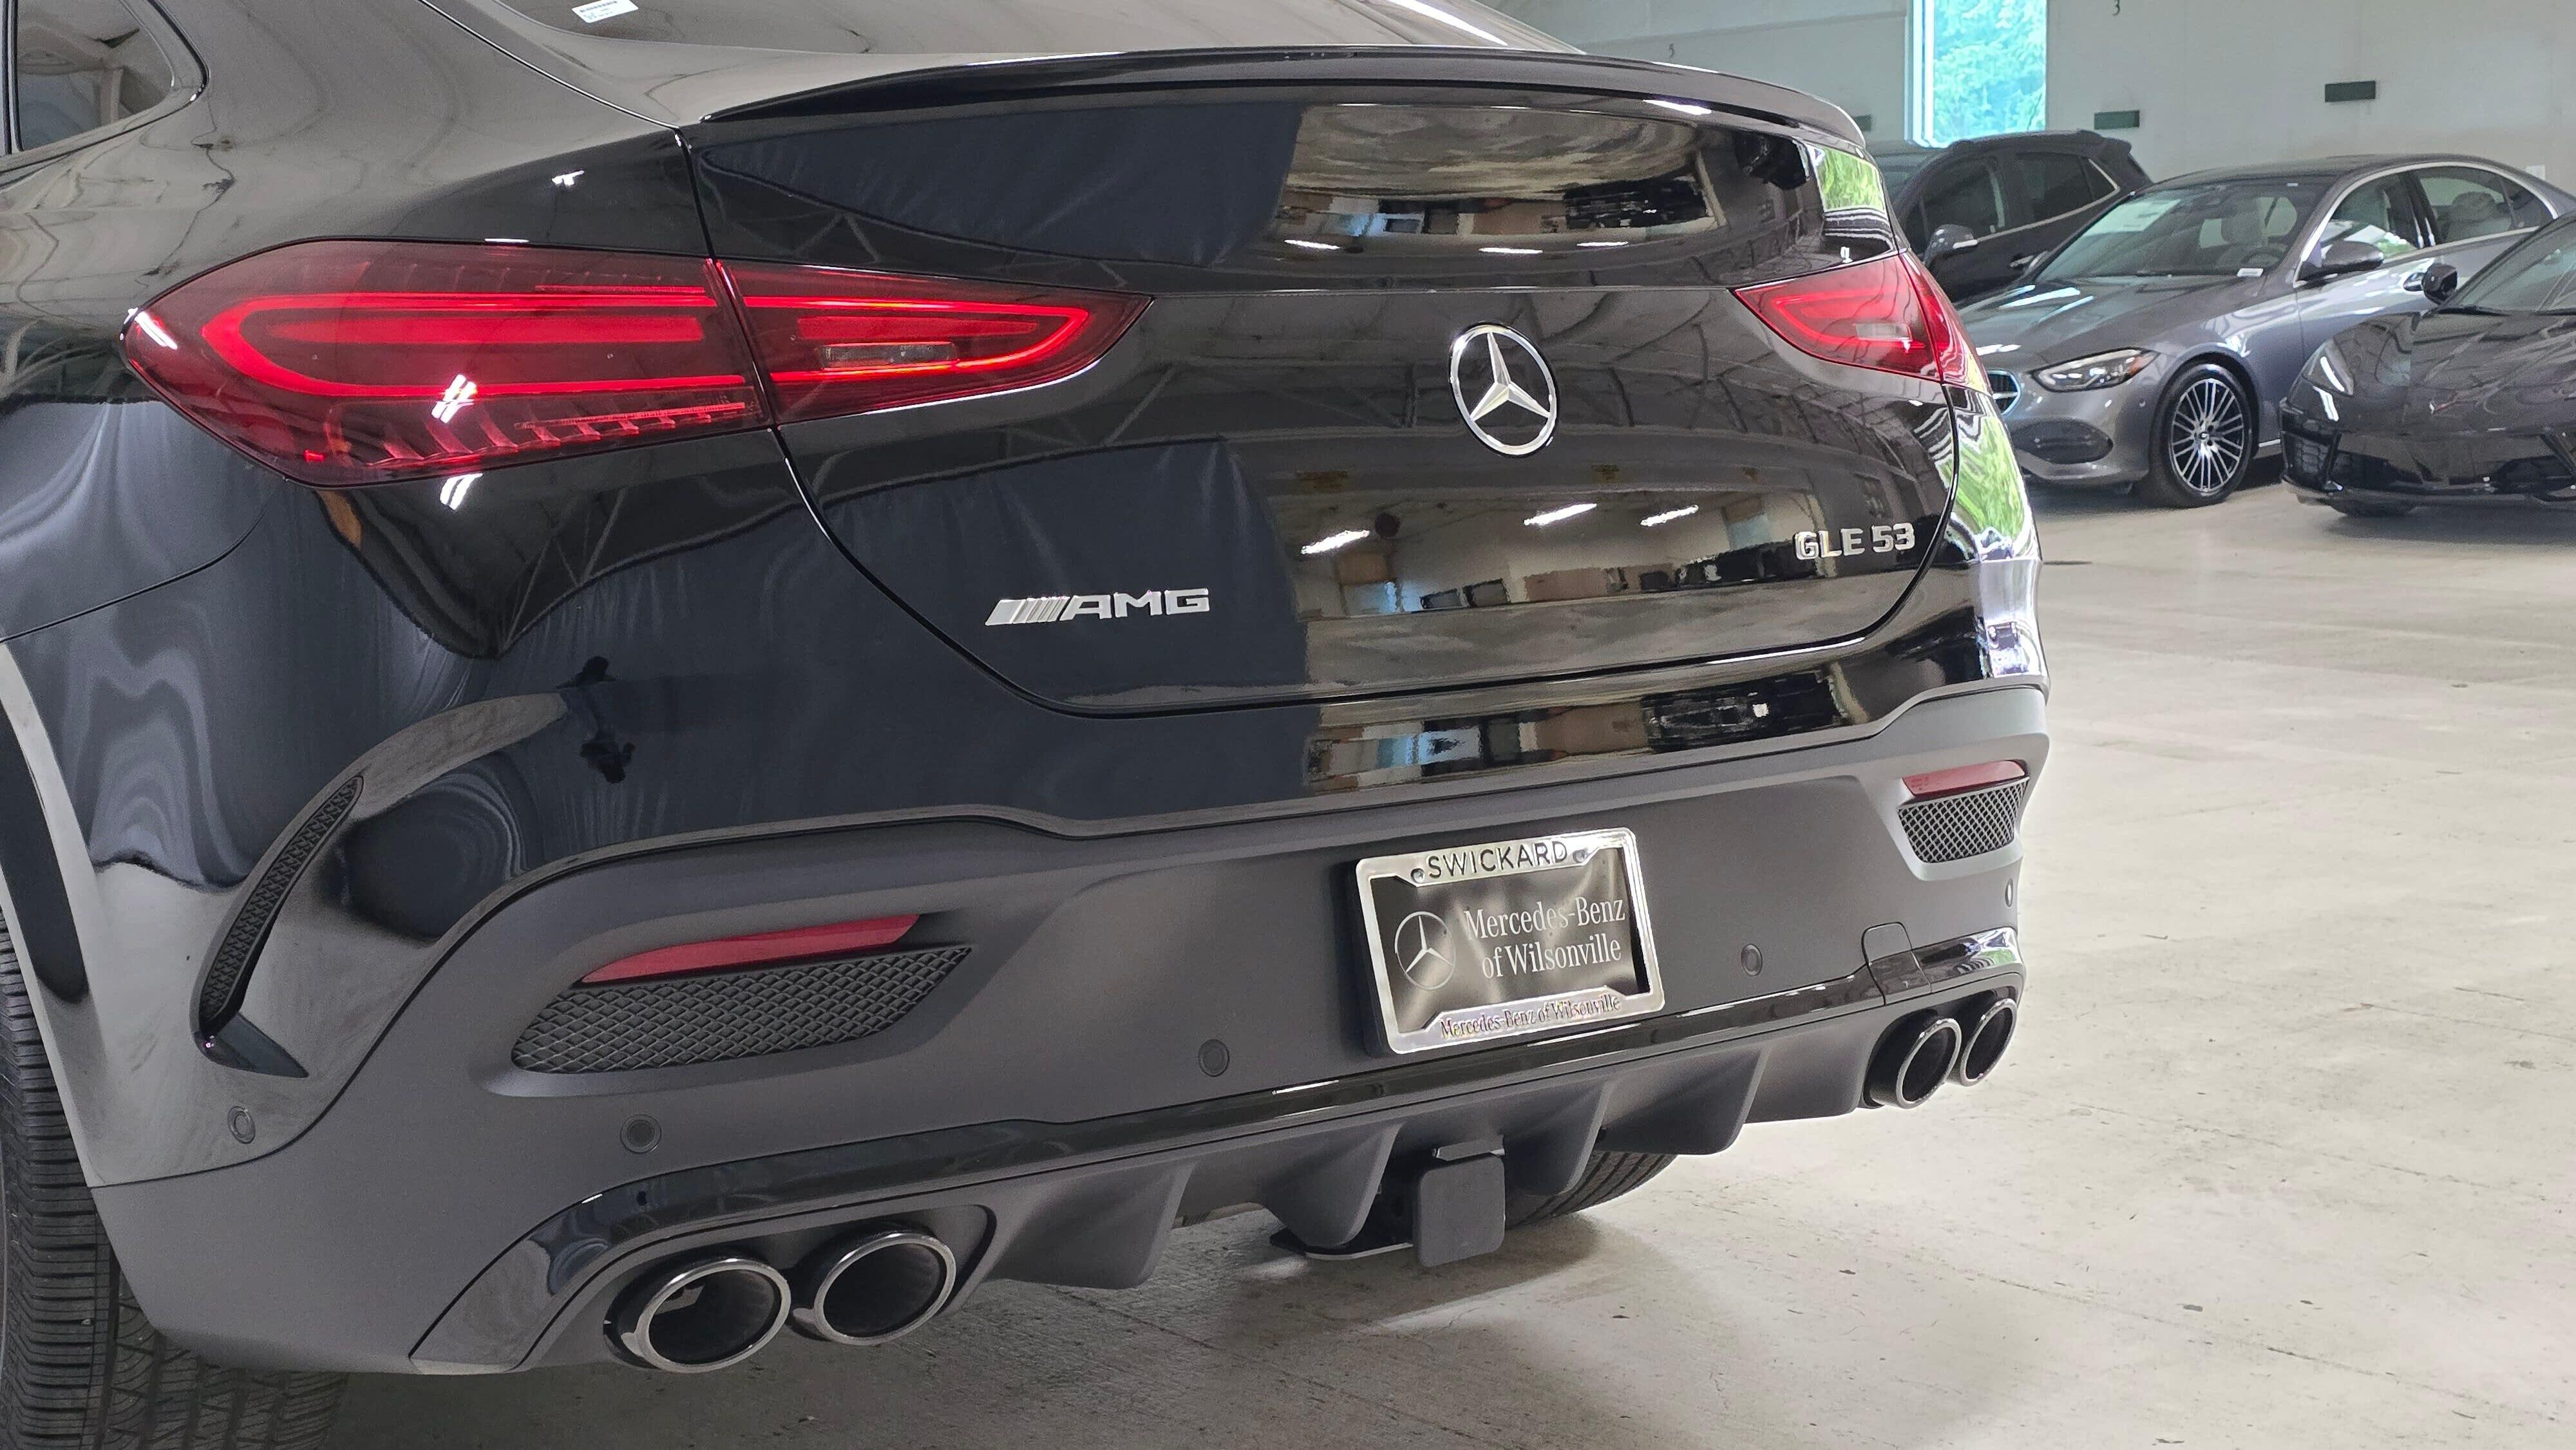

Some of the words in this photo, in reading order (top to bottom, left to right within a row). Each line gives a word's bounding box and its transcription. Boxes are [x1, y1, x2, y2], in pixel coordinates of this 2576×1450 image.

[1795, 527, 1865, 560] GLE
[1871, 522, 1915, 553] 53
[1427, 840, 1567, 878] SWICKARD
[1463, 896, 1625, 939] Mercedes-Benz
[1482, 946, 1504, 979] of
[1504, 932, 1622, 975] Wilsonville
[1439, 1009, 1537, 1039] Mercedes-Benz
[1538, 1002, 1550, 1022] of
[1550, 993, 1620, 1020] Wilsonville
